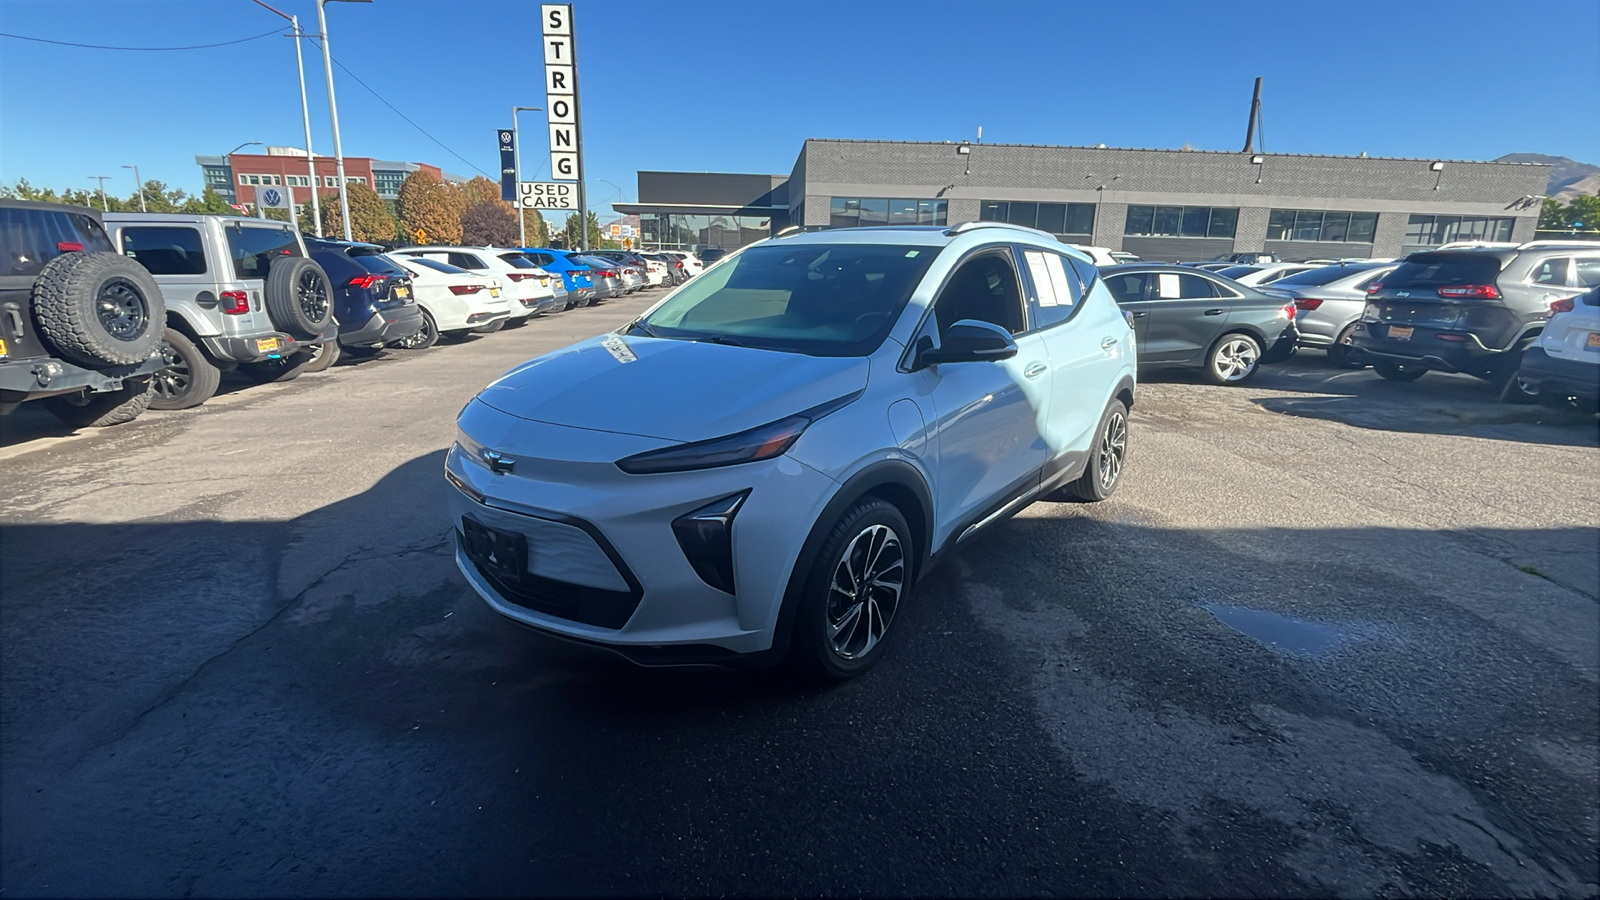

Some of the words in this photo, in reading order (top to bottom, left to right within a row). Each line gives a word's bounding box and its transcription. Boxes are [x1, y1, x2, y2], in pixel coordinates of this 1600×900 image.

[549, 10, 572, 175] STRONG
[520, 184, 569, 195] USED
[522, 196, 570, 207] CARS
